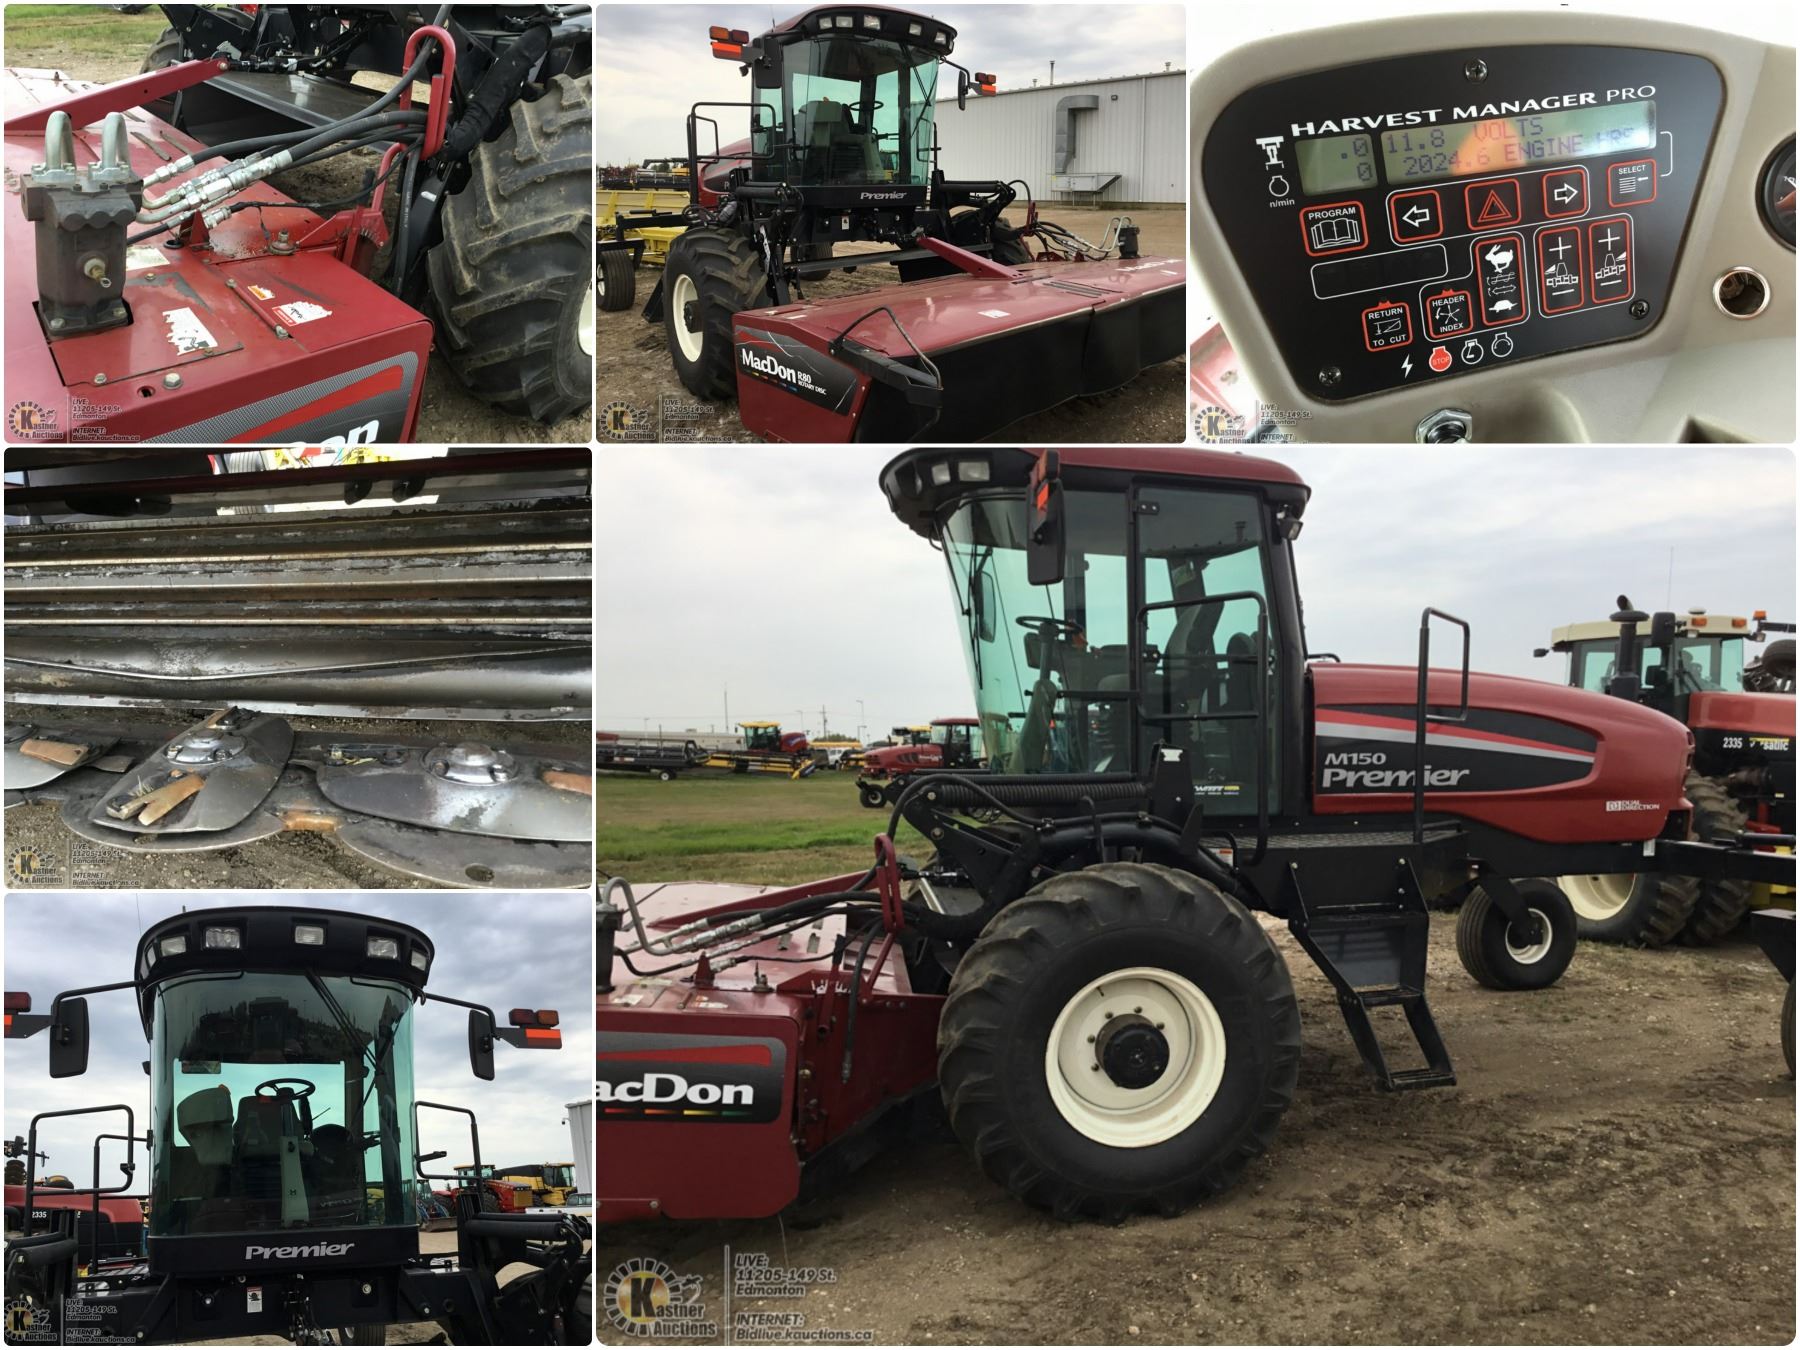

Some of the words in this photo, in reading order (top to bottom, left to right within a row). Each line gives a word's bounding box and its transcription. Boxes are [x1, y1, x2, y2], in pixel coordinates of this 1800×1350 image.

[1291, 109, 1443, 137] HARVEST
[1453, 92, 1598, 120] MANAGER
[1606, 85, 1656, 102] PRO
[1387, 128, 1446, 154] 11.8
[1473, 116, 1545, 142] VOLTS
[1403, 147, 1491, 177] 2024.6
[1503, 133, 1584, 163] ENGINE
[1618, 164, 1647, 175] SELECT
[860, 191, 908, 200] Premier
[1269, 198, 1296, 208] n/min
[1308, 207, 1357, 221] PROGRAM
[1432, 295, 1466, 308] HEADER
[1368, 307, 1404, 320] RETURN
[1439, 322, 1465, 333] INDEX
[1373, 339, 1385, 347] TO
[1389, 334, 1408, 344] CUT
[741, 348, 797, 384] MacDon
[1432, 356, 1451, 366] STOP
[797, 371, 812, 383] R80
[1723, 737, 1743, 749] 2335
[1325, 752, 1387, 765] M150
[1322, 765, 1470, 788] Premier
[245, 1241, 355, 1260] Premier
